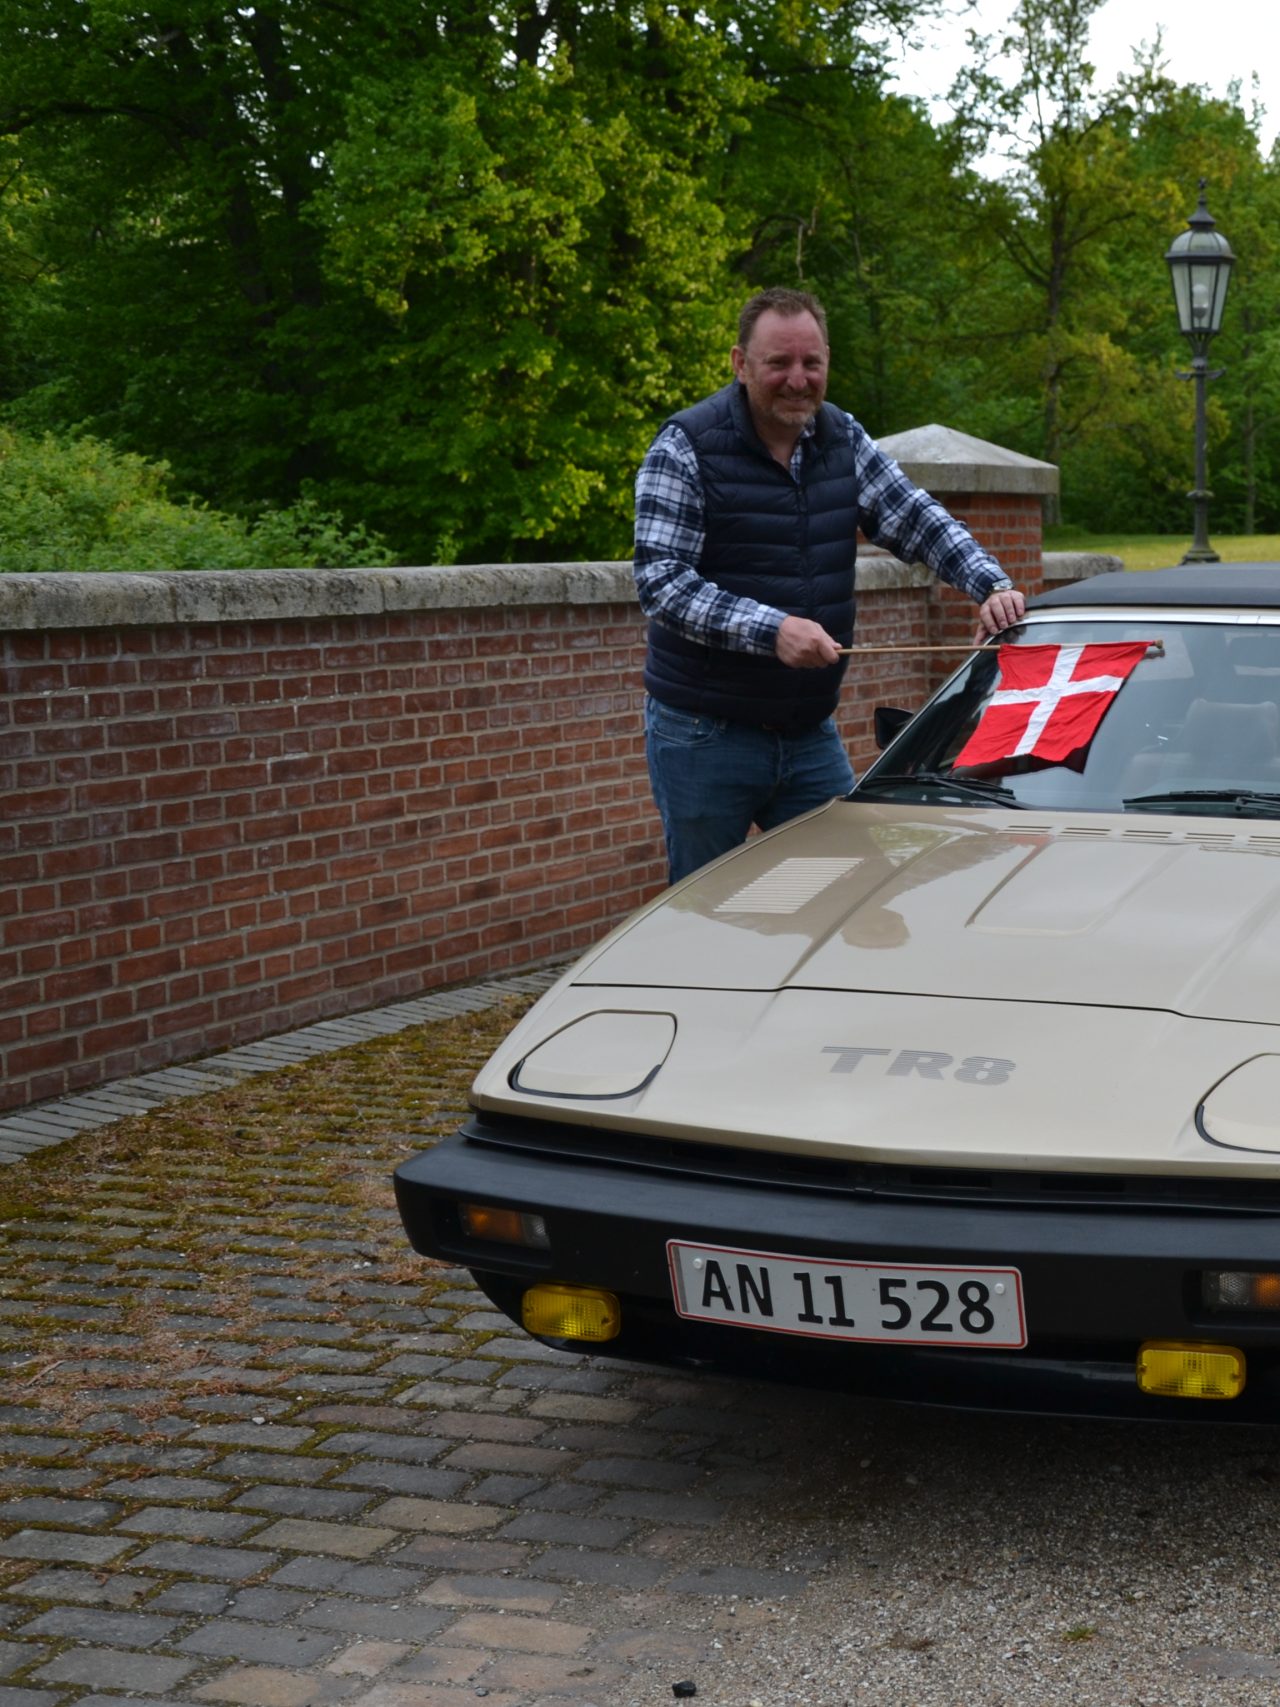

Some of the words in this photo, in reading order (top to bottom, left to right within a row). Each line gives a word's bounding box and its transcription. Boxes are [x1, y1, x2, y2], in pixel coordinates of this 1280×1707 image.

[820, 1045, 1017, 1086] TR8
[701, 1259, 774, 1318] AN
[793, 1271, 855, 1328] 11
[878, 1277, 995, 1335] 528
